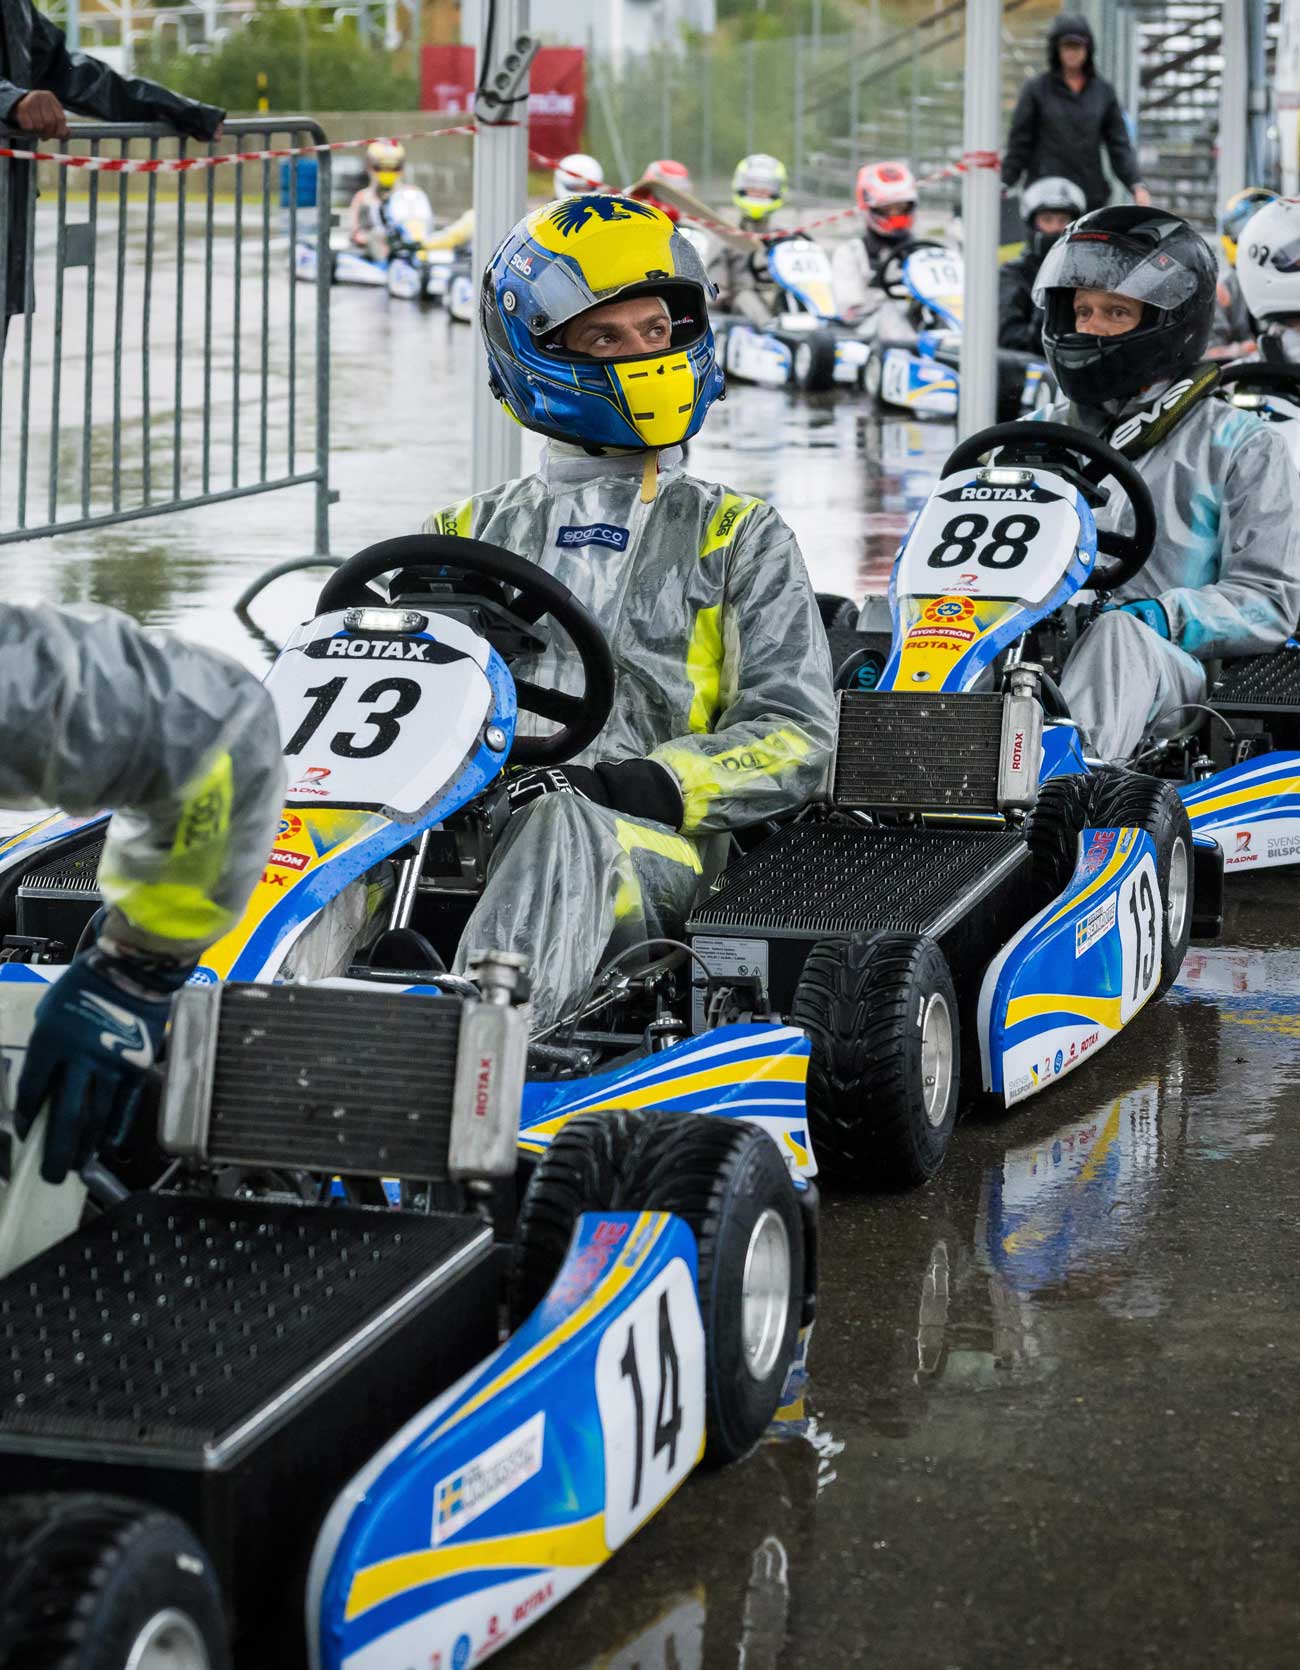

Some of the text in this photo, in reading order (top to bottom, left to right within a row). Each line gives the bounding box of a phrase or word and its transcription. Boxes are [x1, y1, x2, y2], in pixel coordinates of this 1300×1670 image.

[960, 487, 1036, 501] ROTAX
[563, 528, 623, 546] sparco
[927, 513, 1041, 569] 88
[326, 639, 431, 661] ROTAX
[905, 641, 963, 651] ROTAX
[281, 676, 422, 759] 13
[1012, 732, 1024, 770] ROTAX
[287, 787, 331, 796] ADNE
[1226, 854, 1258, 864] RADNE
[1129, 870, 1155, 1001] 13
[1081, 1032, 1099, 1053] ROTAX
[475, 1058, 491, 1116] ROTAX
[618, 1288, 682, 1510] 14
